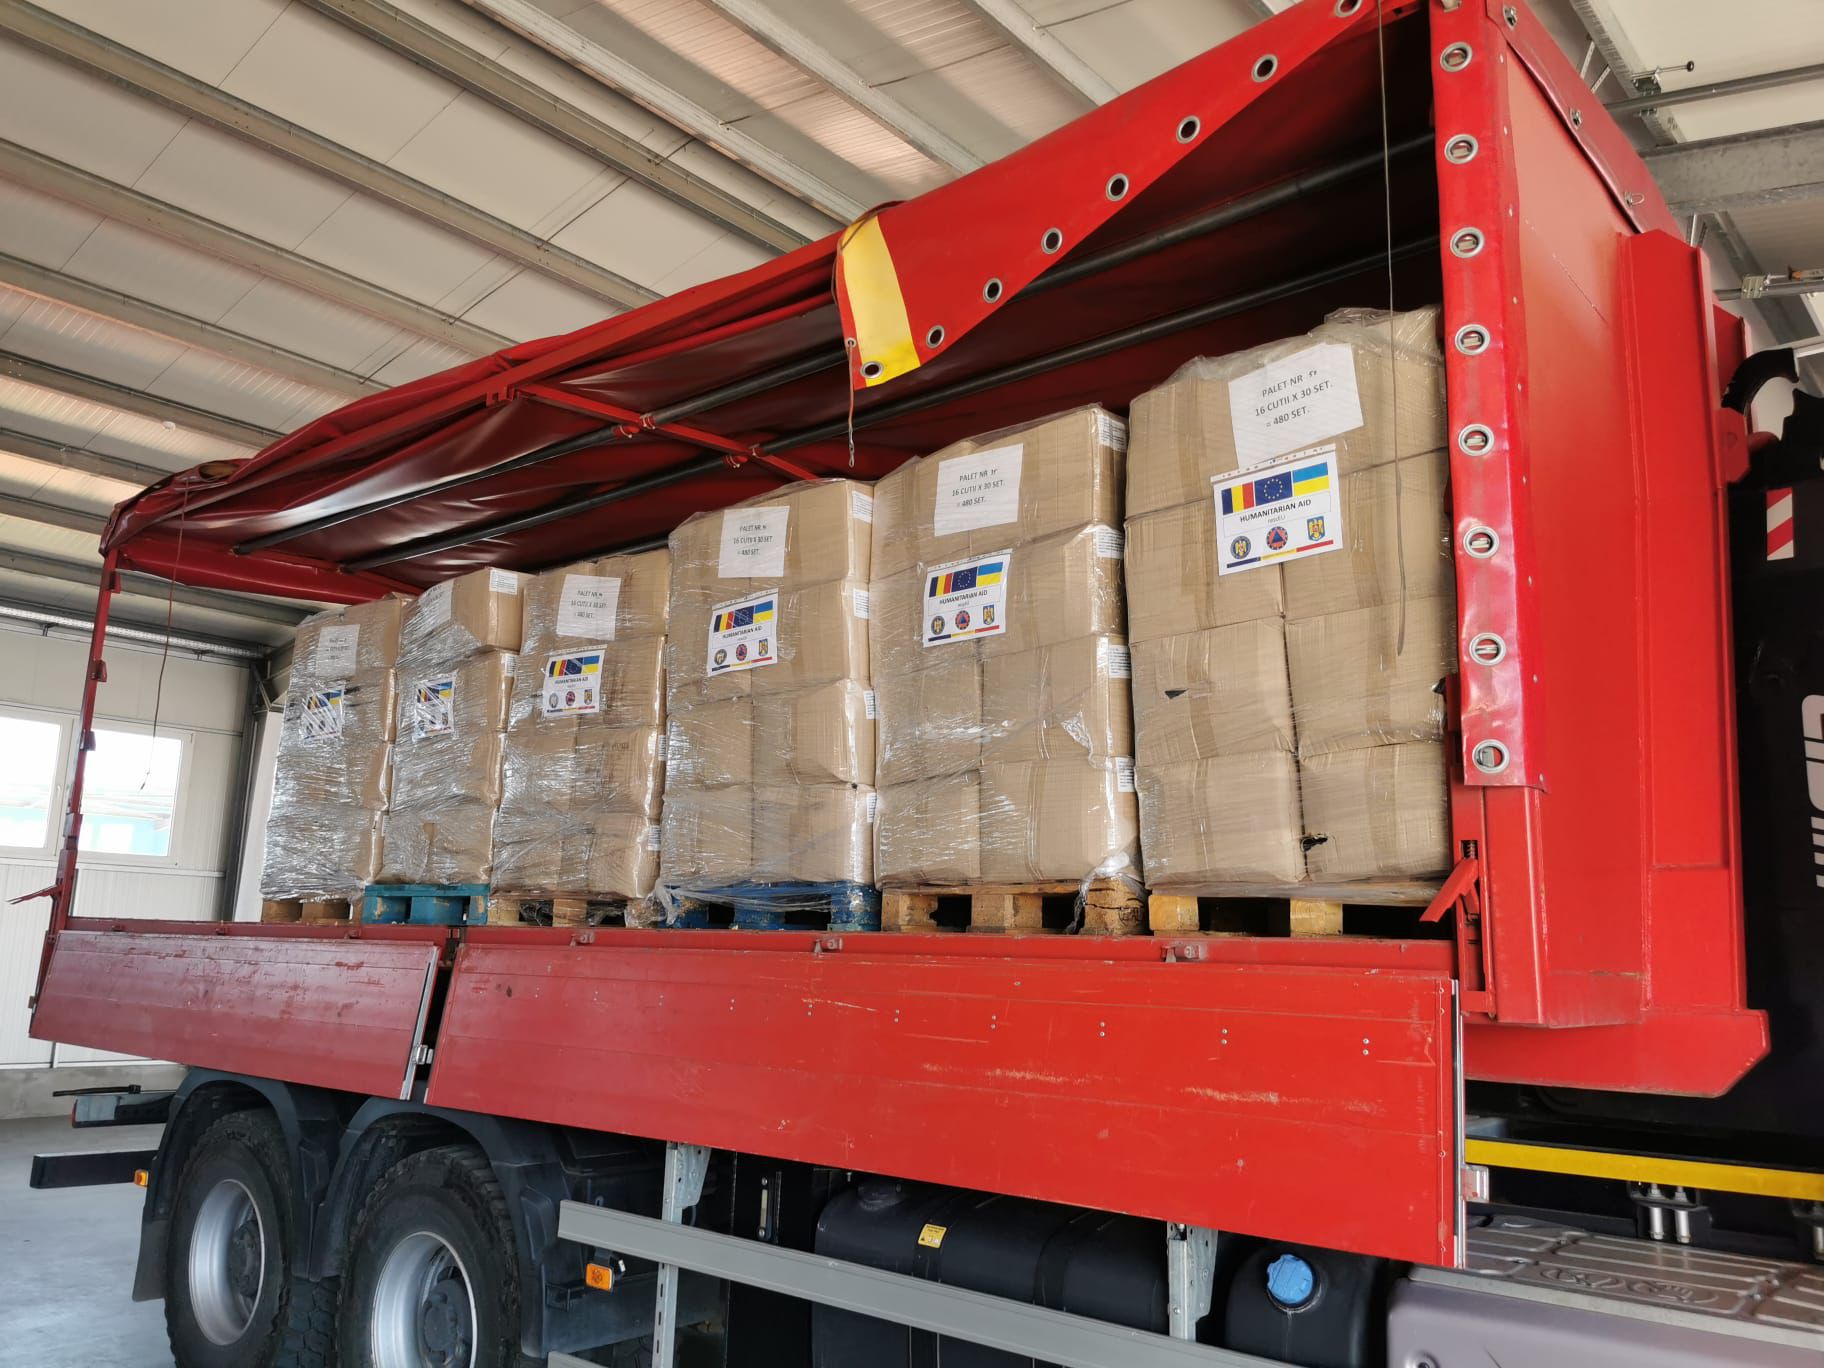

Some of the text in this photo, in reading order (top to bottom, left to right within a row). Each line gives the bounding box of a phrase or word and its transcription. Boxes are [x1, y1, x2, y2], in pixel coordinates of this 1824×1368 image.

[1262, 381, 1288, 397] PALET
[1255, 406, 1265, 416] 16
[1267, 397, 1290, 411] CUTII
[1292, 393, 1298, 401] X
[1301, 388, 1311, 399] 30
[1273, 413, 1289, 425] 480
[959, 472, 978, 482] PALET
[960, 485, 976, 494] CUTII
[962, 498, 973, 506] 480
[1240, 499, 1311, 522] HUMANITARIAN AID
[939, 592, 977, 604] HUMANITARIAN
